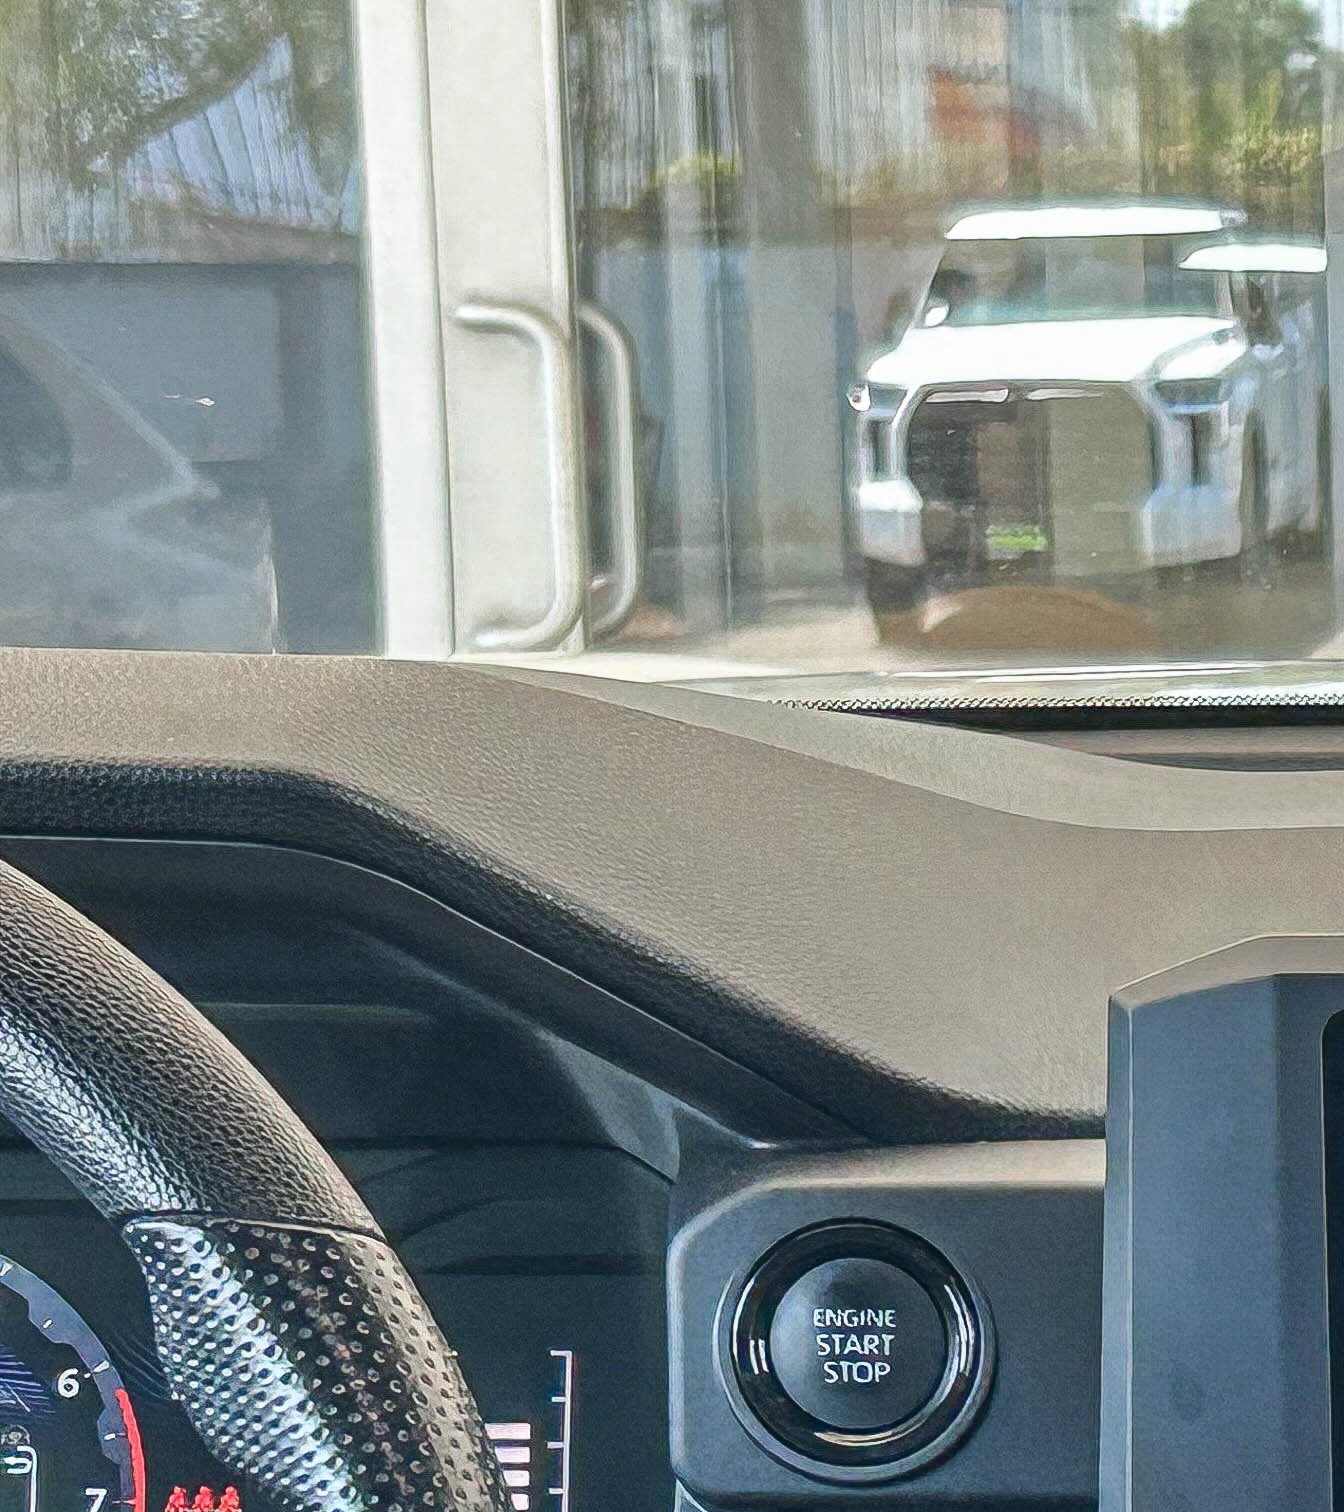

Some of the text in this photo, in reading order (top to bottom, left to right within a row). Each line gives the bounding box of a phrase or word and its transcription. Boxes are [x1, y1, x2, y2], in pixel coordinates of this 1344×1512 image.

[812, 1308, 897, 1328] ENGINE
[816, 1334, 896, 1356] START
[57, 1367, 80, 1398] 6
[823, 1361, 892, 1384] STOP
